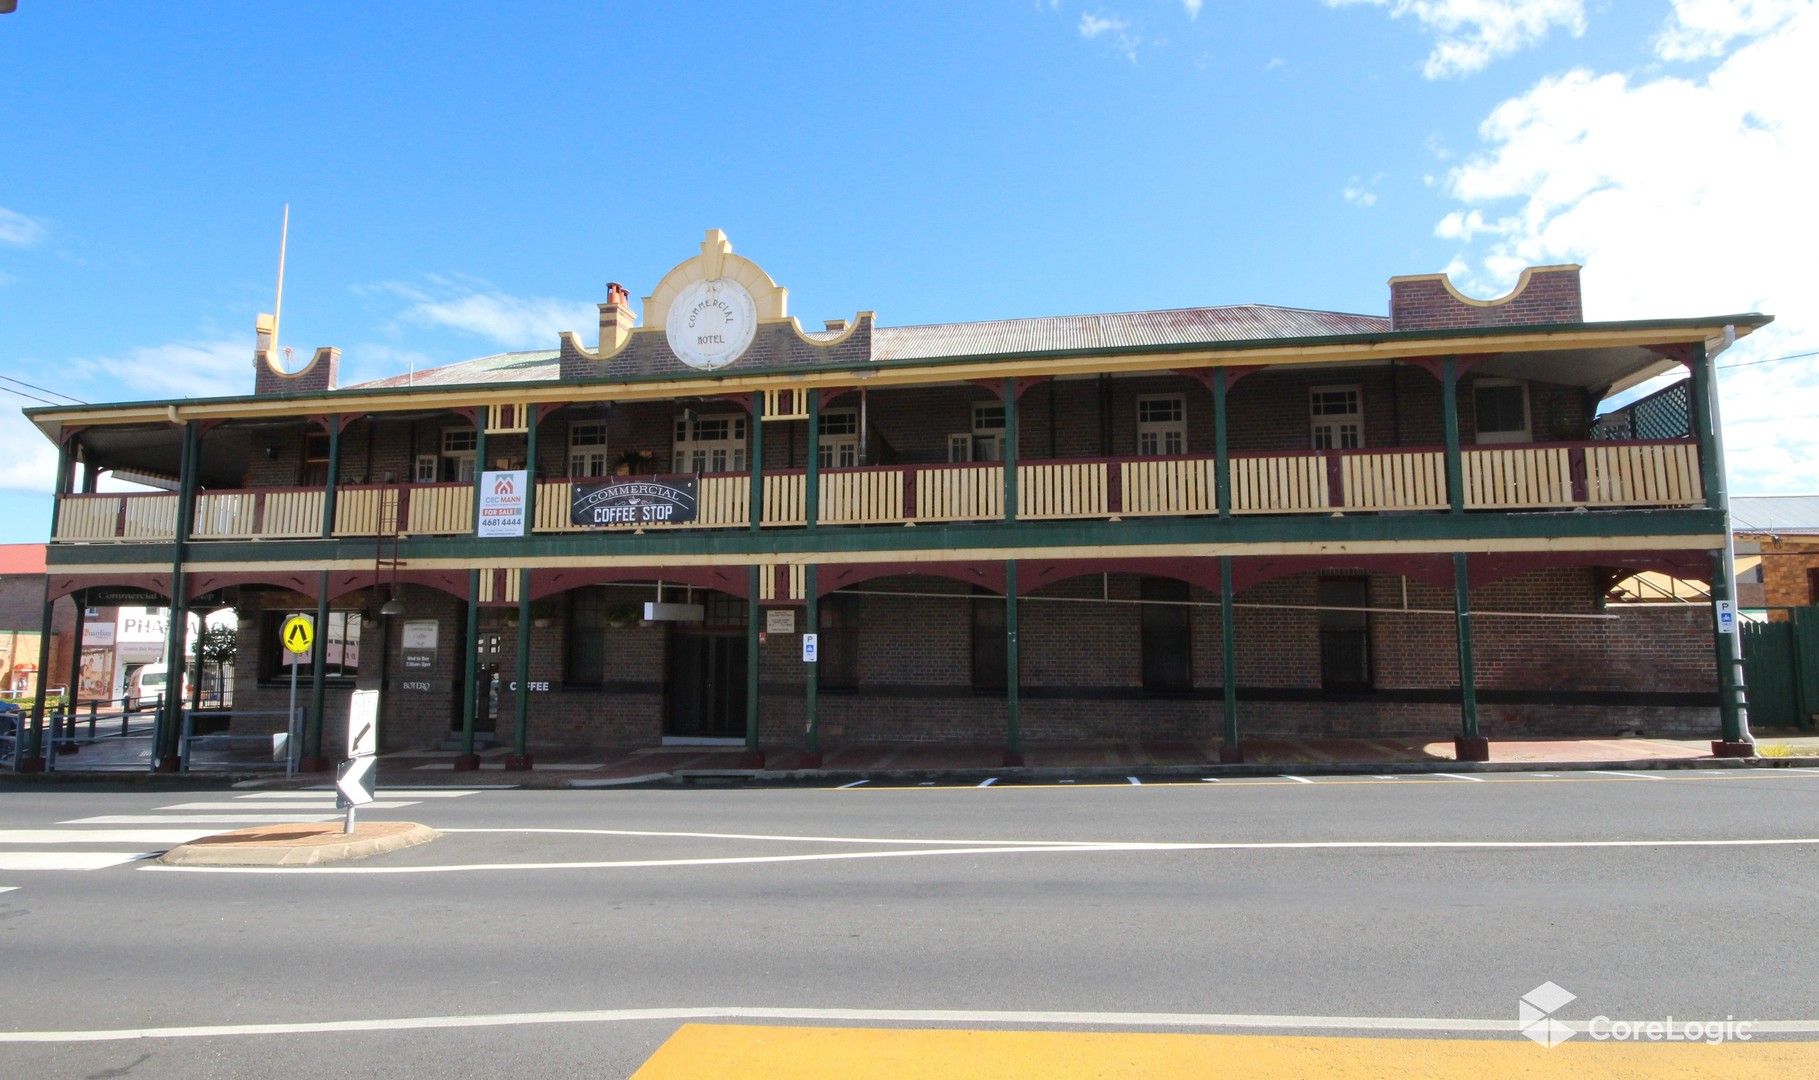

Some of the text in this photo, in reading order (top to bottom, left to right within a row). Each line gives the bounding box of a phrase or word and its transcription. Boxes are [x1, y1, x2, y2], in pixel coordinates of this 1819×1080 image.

[689, 299, 733, 328] COMMERCIAL
[698, 335, 725, 344] HOTEL
[588, 485, 680, 503] COMMERCIAL
[482, 518, 521, 526] 4681 4444
[594, 505, 673, 522] COFFEE STOP
